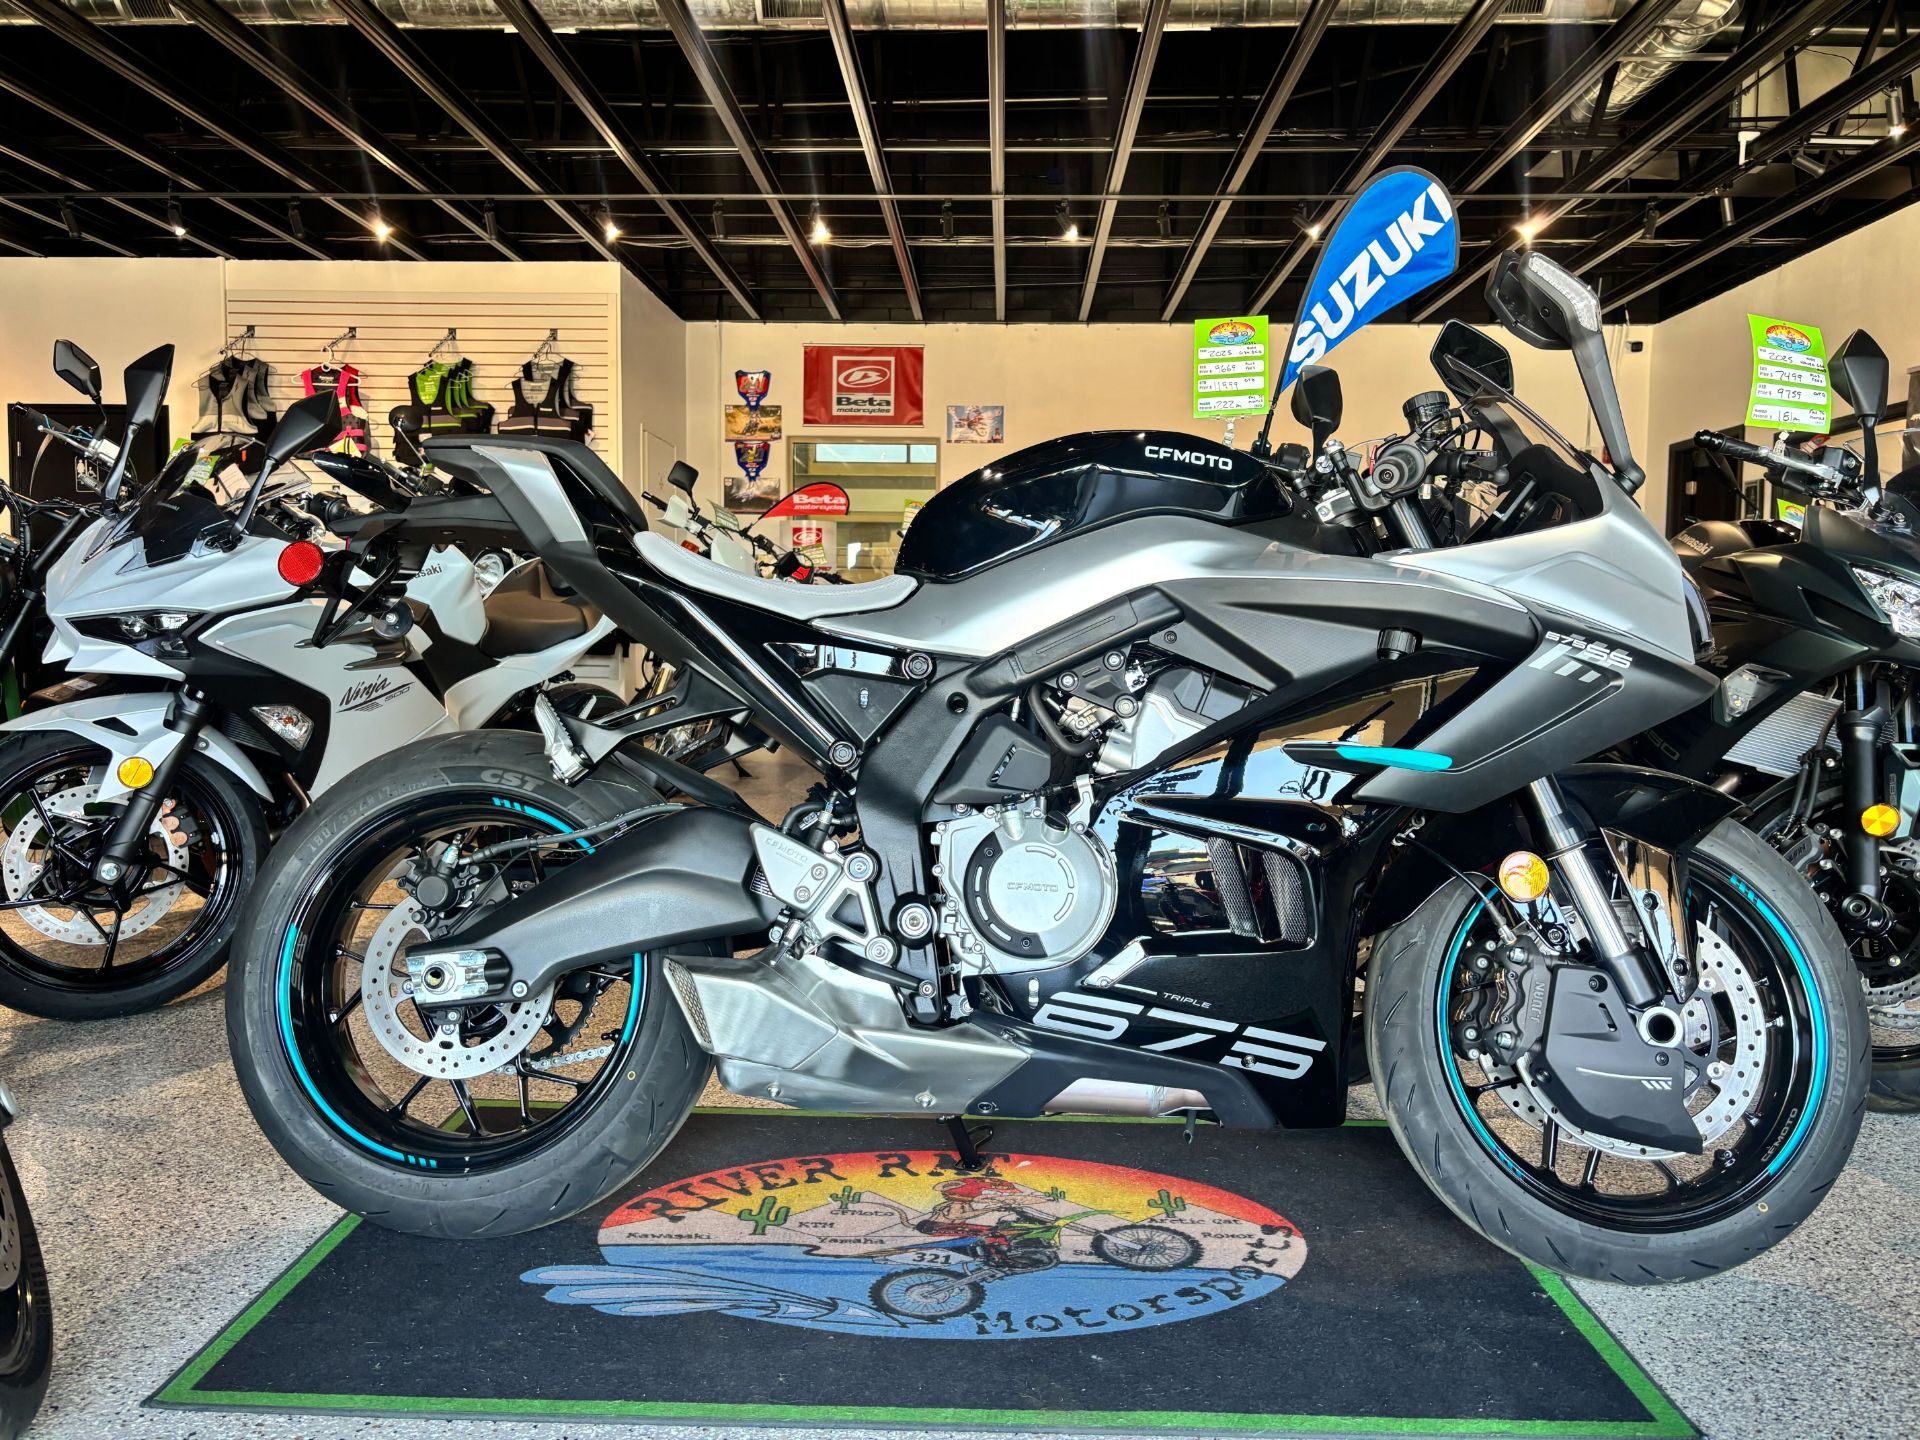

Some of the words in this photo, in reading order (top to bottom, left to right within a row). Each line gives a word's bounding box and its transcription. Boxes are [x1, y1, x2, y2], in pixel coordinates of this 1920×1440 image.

[1288, 182, 1453, 374] SUZUKI
[1768, 353, 1793, 364] 2025
[1775, 370, 1803, 382] 7499
[836, 396, 891, 406] Beta
[1144, 445, 1233, 471] CFMOTO
[793, 494, 846, 504] Beta
[339, 674, 391, 707] Ninja
[384, 686, 411, 703] 500
[480, 769, 547, 792] CST
[1007, 882, 1059, 892] CFMOTO
[1163, 991, 1213, 1009] TRIPLE
[1032, 991, 1327, 1080] 675
[1760, 1107, 1799, 1163] CFMOTO
[626, 1155, 847, 1222] RIVER
[829, 1207, 895, 1217] CFMoto
[797, 1221, 836, 1229] KTM
[1212, 1217, 1242, 1226] Cat
[626, 1232, 713, 1240] Kawasaki
[816, 1236, 886, 1246] Yamaha
[912, 1251, 952, 1266] 321
[971, 1223, 1293, 1335] Motorsports
